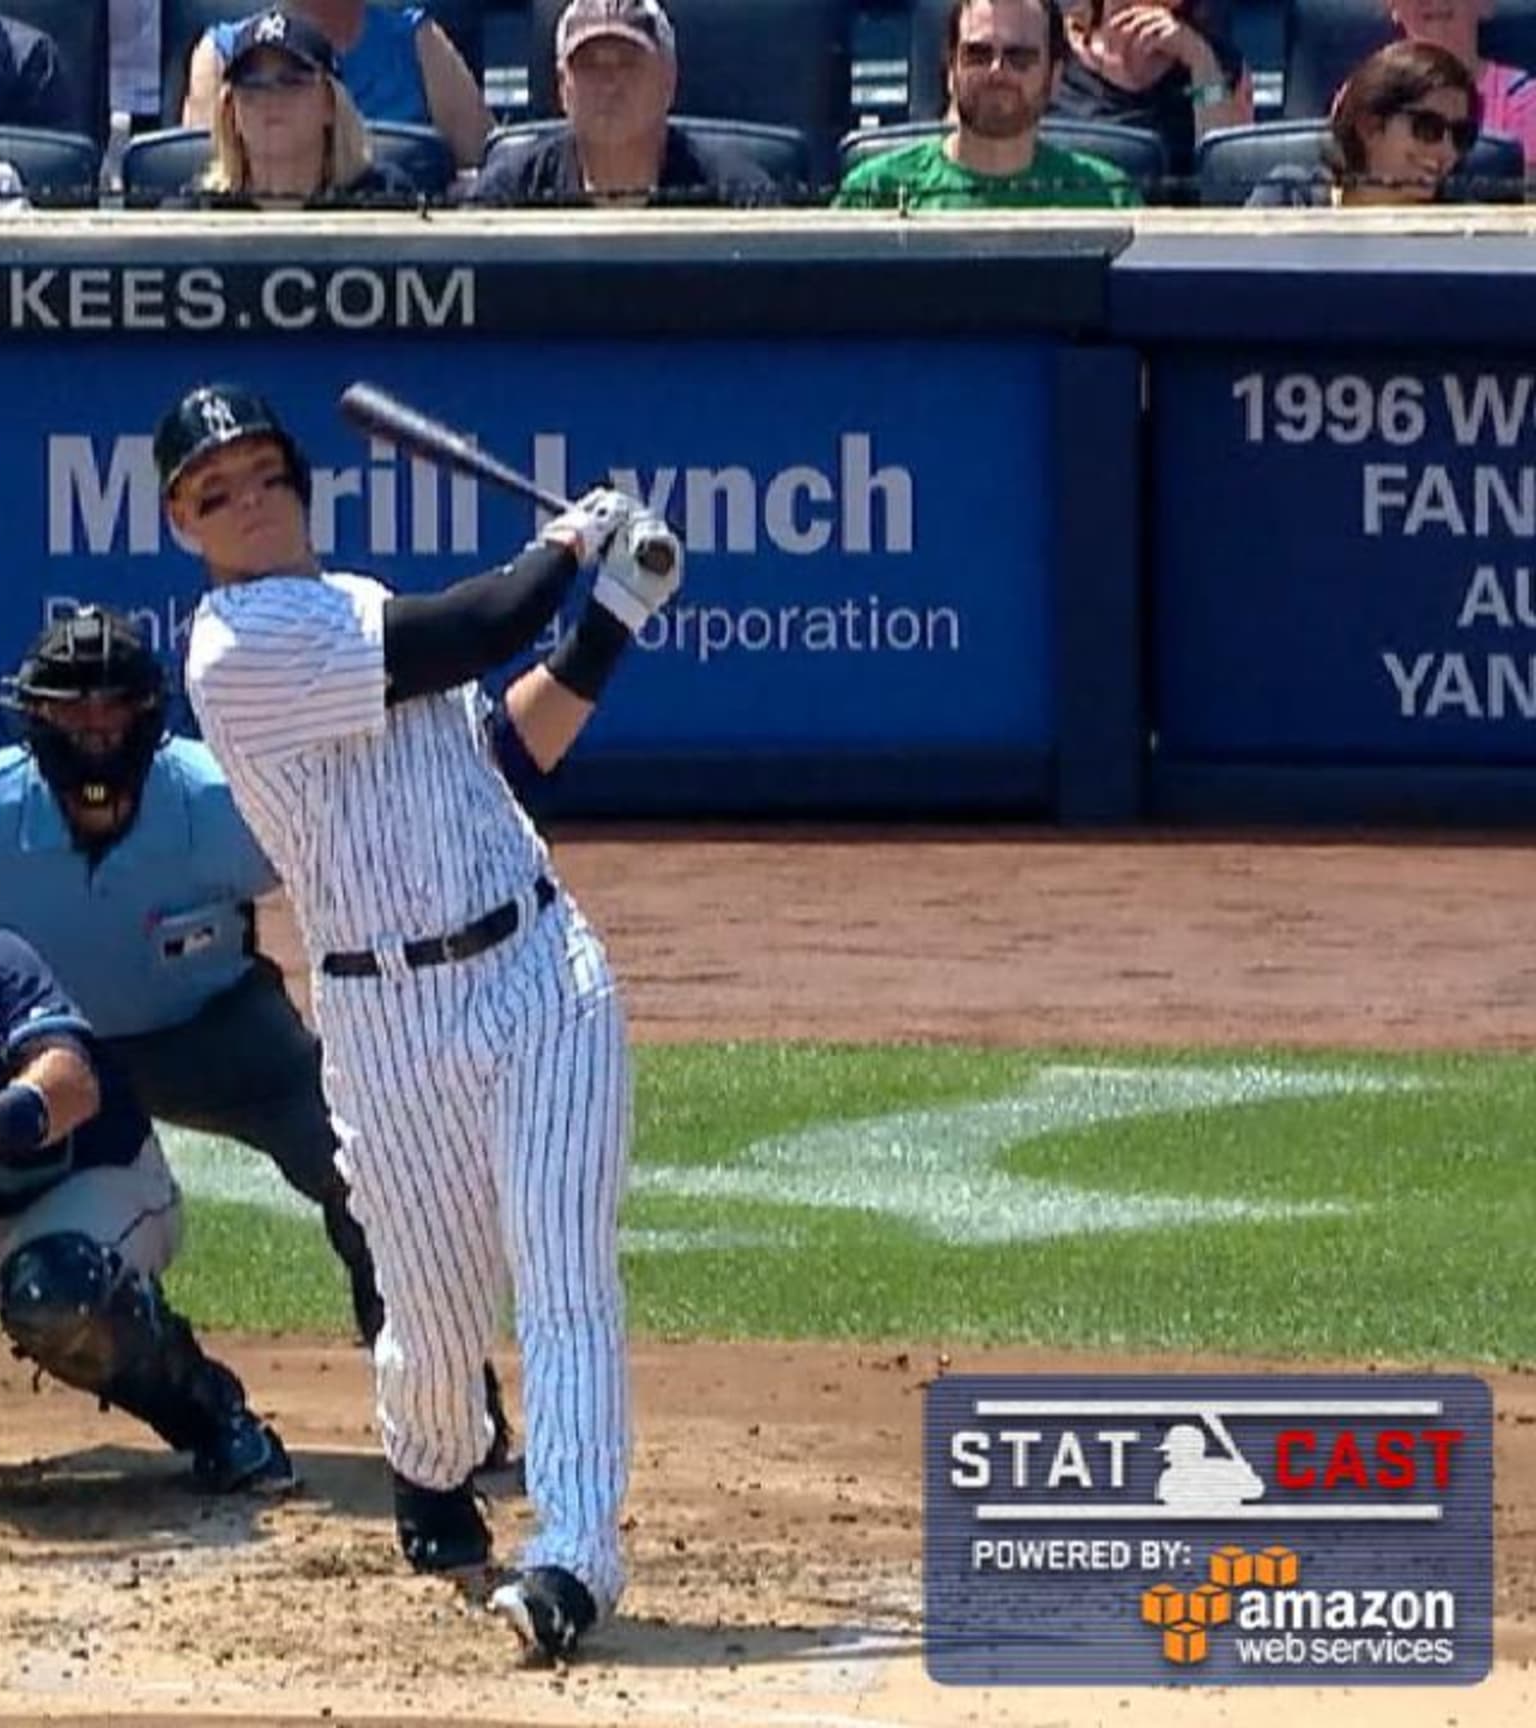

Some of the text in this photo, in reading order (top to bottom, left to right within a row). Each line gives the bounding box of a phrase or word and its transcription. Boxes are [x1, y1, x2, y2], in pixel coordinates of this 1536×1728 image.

[1233, 374, 1536, 446] 1996 W
[48, 433, 480, 555] Mrill
[1363, 464, 1536, 537] FAN
[636, 596, 961, 662] orporation
[1382, 651, 1536, 719] YAN
